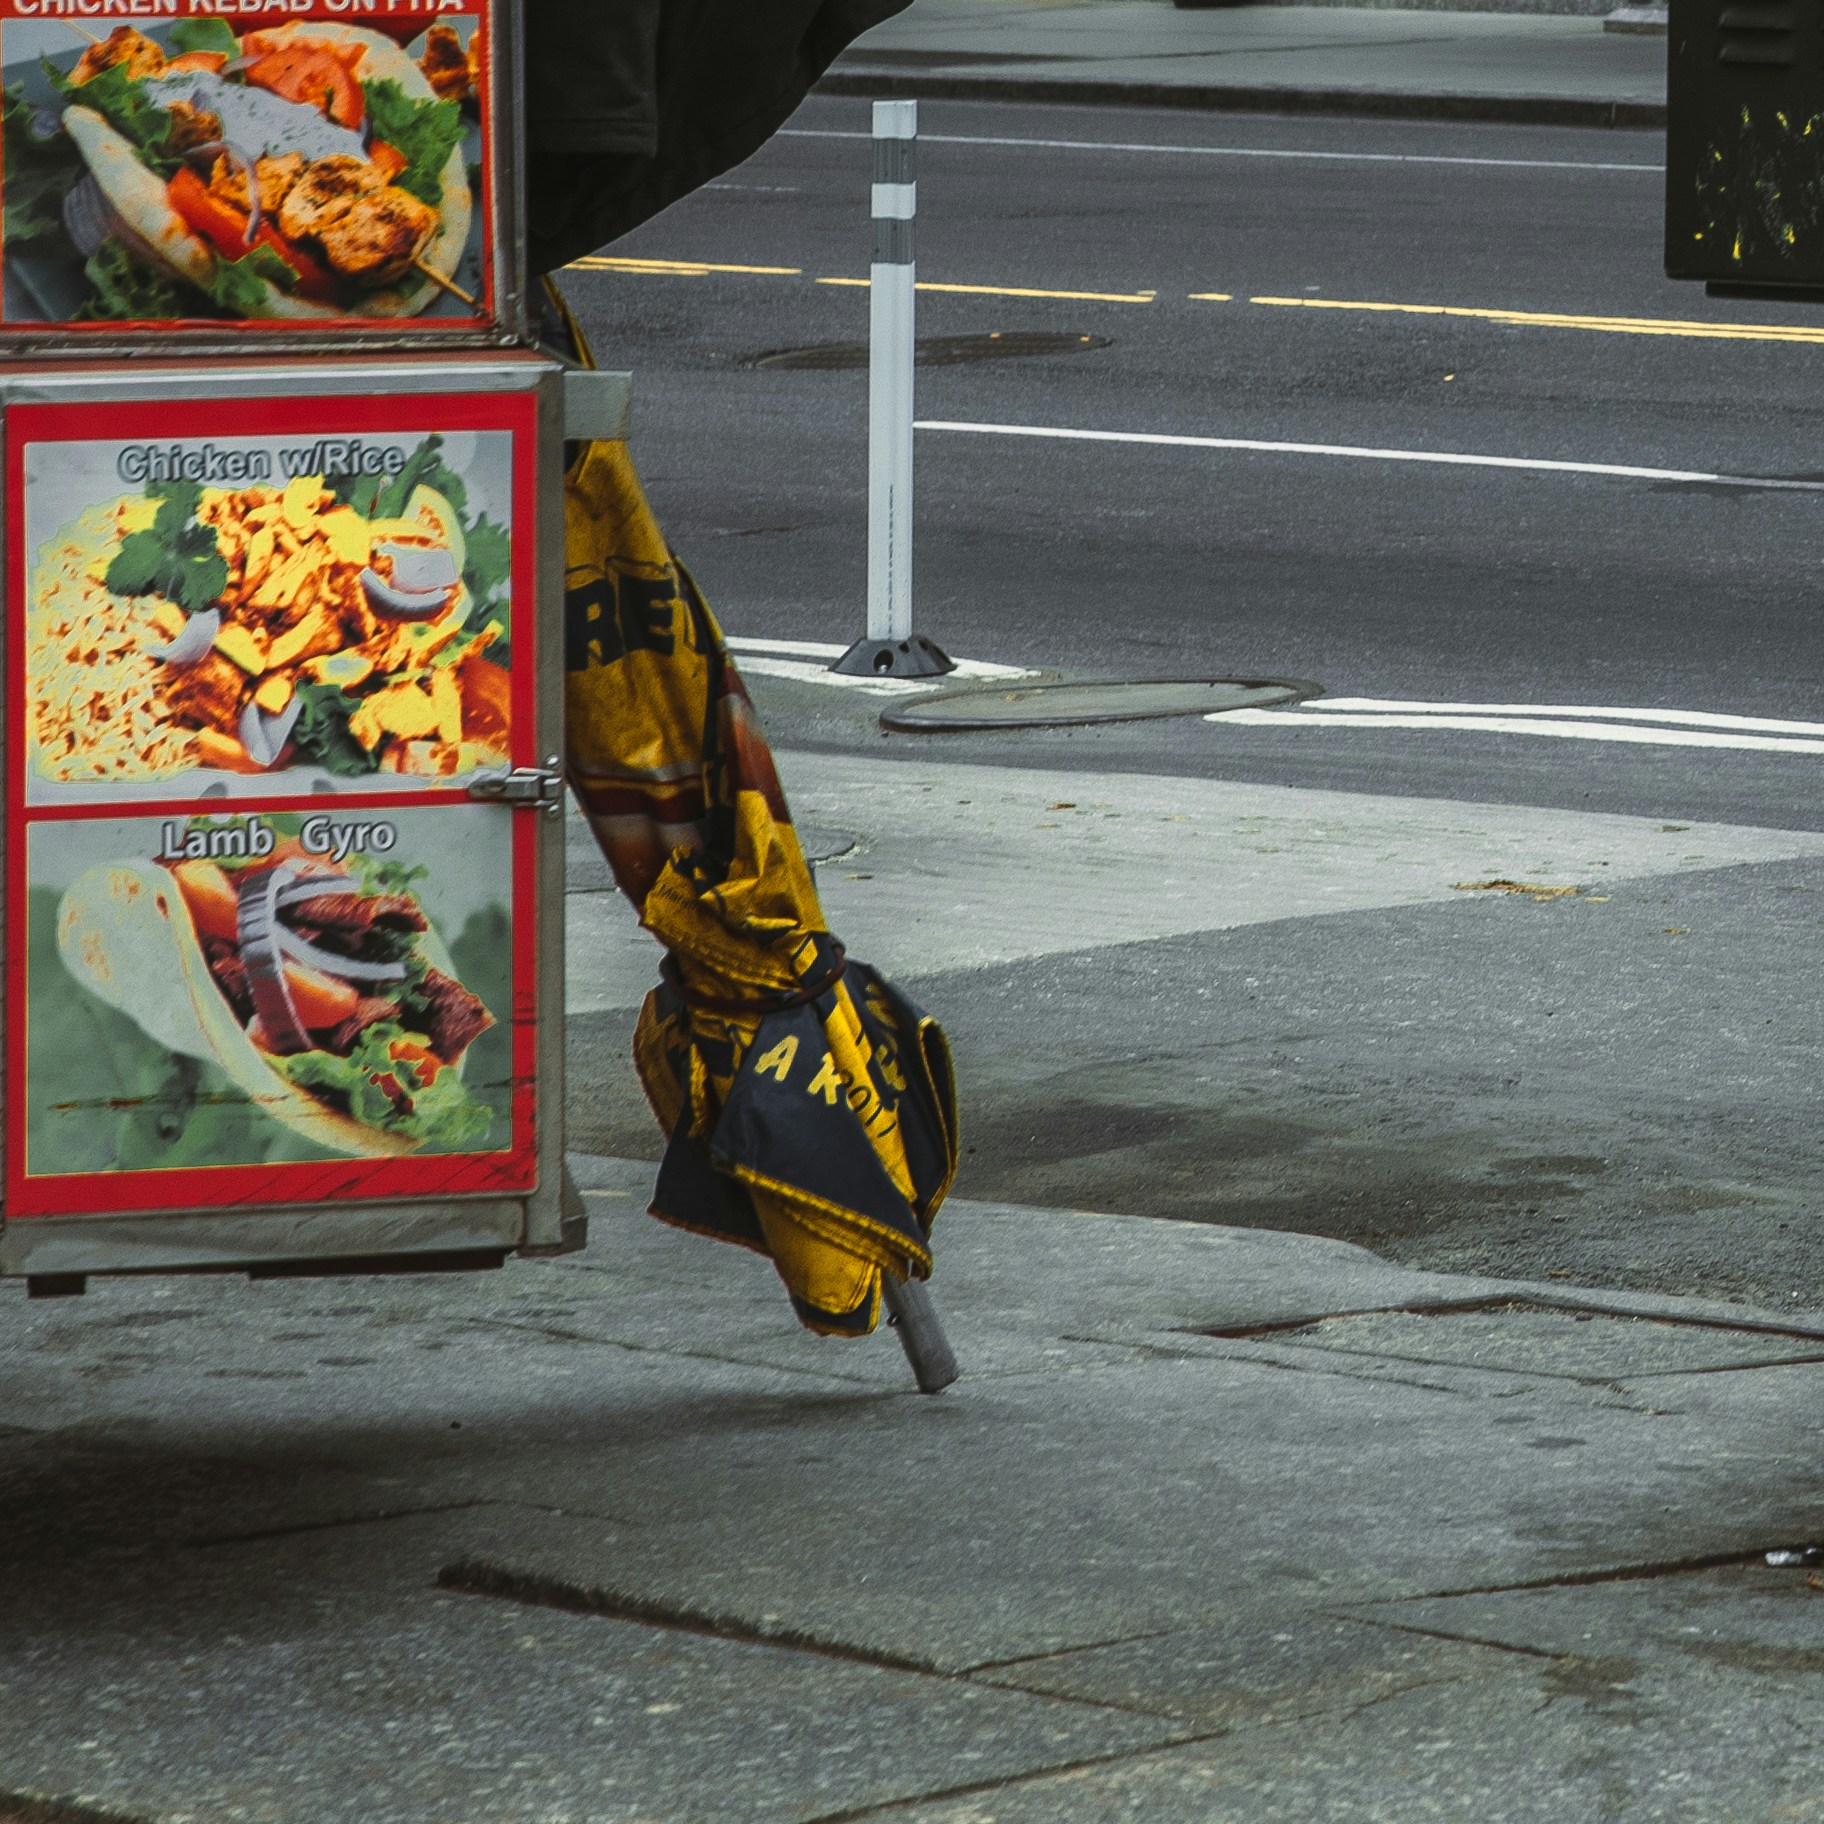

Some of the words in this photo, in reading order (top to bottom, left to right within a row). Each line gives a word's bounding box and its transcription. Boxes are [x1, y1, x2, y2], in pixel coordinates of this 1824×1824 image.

[117, 443, 272, 482] Chicken
[279, 440, 406, 475] w/Rice
[160, 818, 275, 860] Lamb
[300, 815, 398, 863] Gyro
